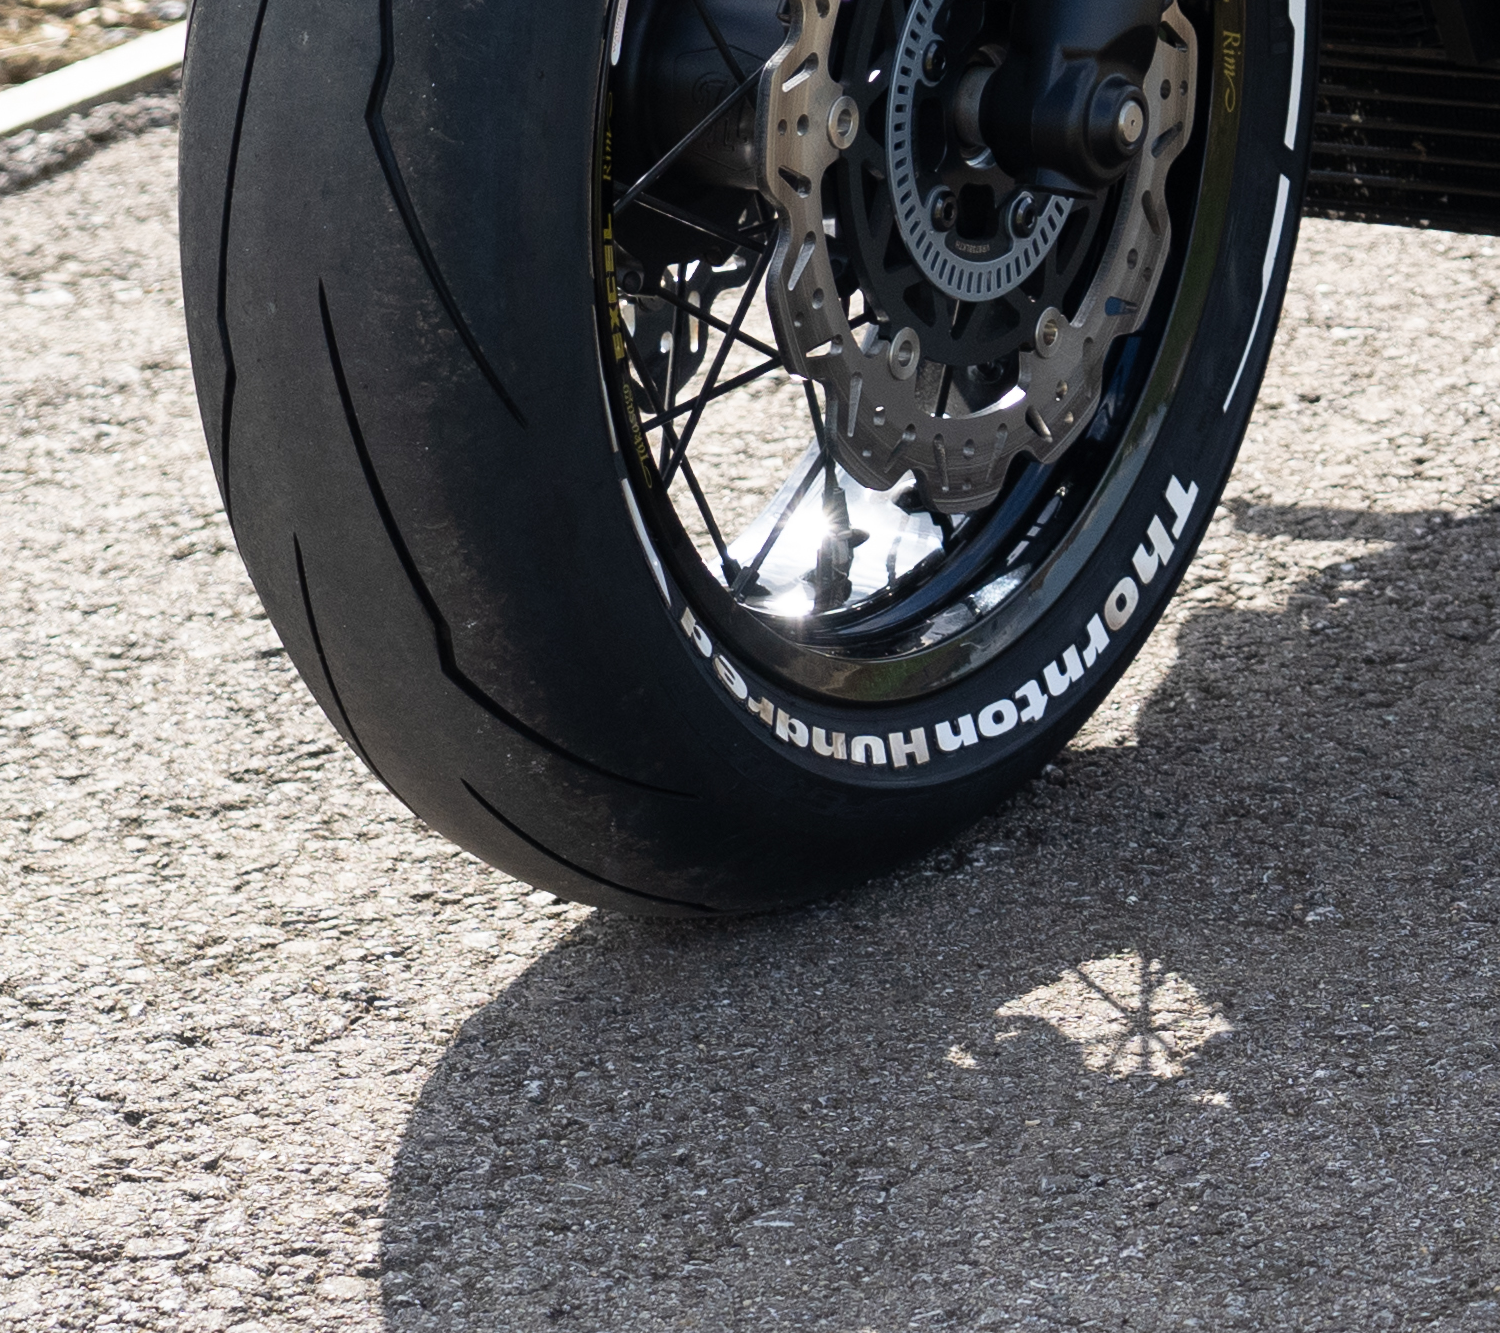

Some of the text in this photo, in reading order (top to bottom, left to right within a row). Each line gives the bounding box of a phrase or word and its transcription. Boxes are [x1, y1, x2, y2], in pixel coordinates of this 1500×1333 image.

[602, 213, 626, 361] EXCEL
[679, 474, 1200, 769] Thornton Hundred
